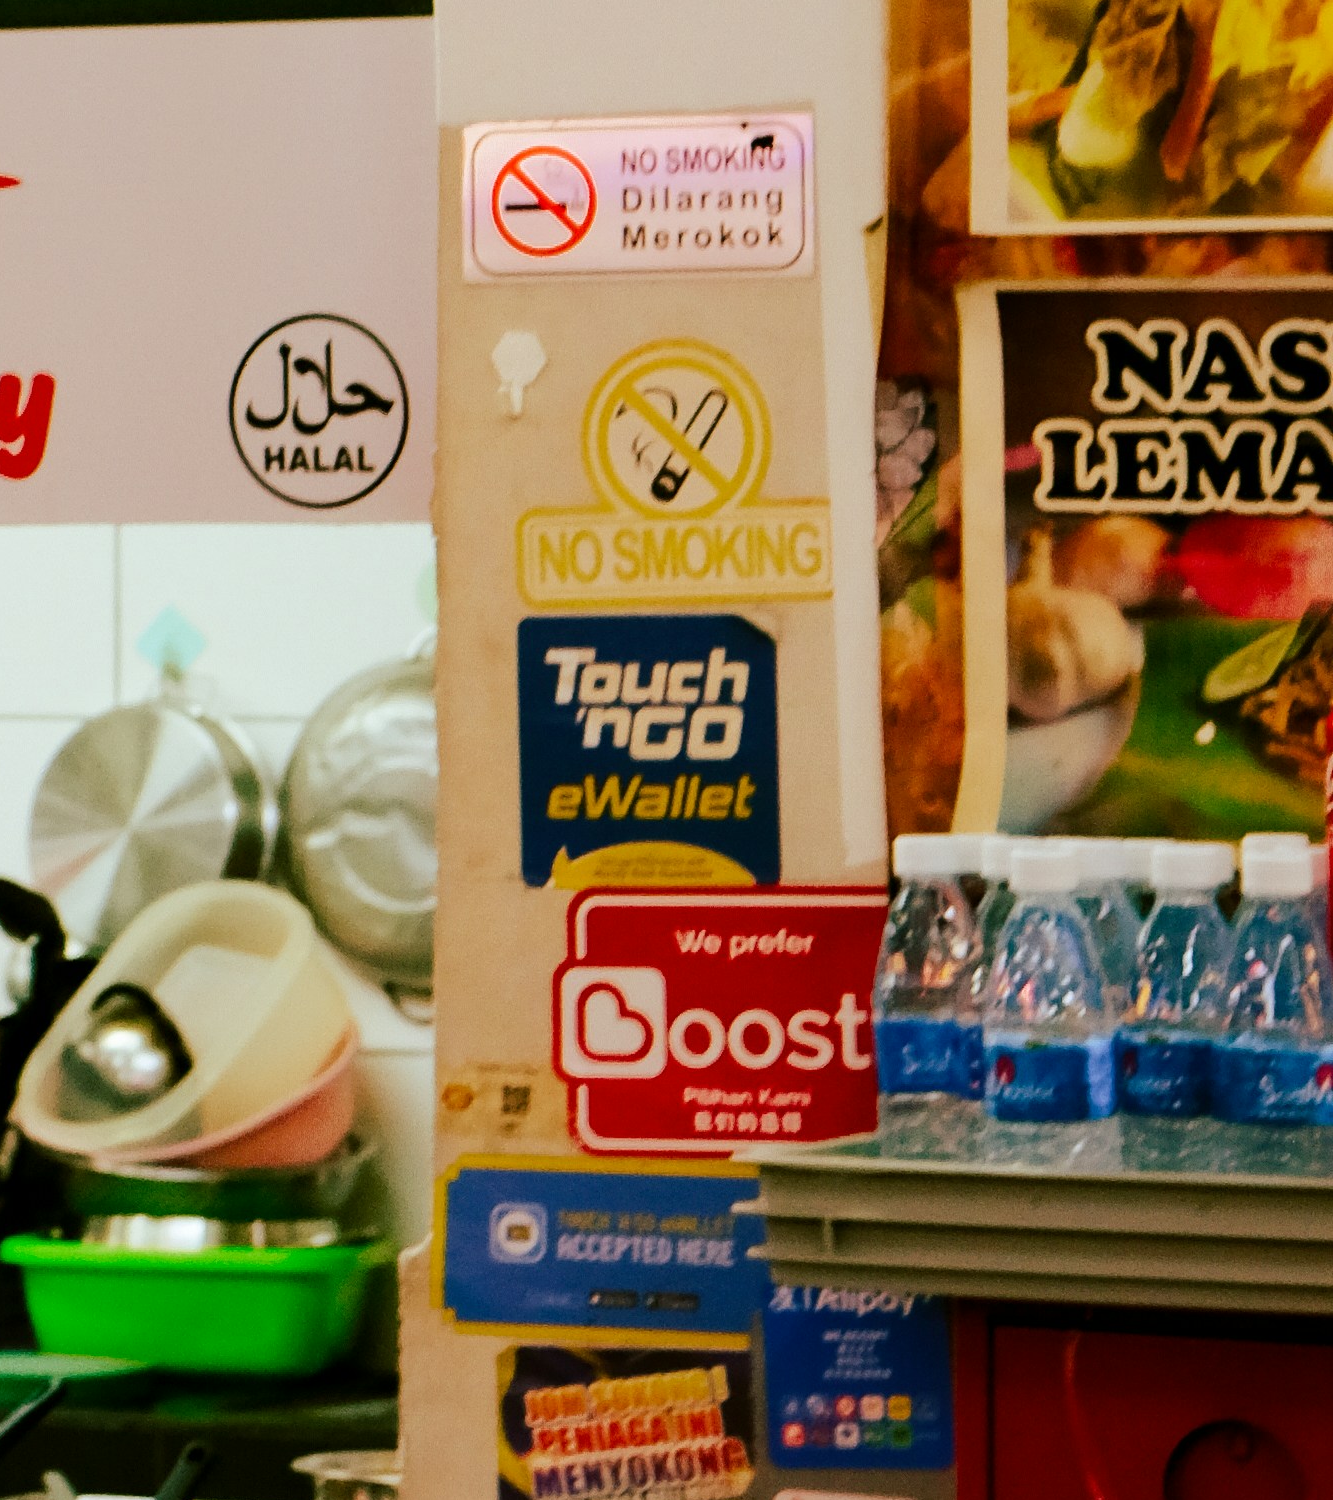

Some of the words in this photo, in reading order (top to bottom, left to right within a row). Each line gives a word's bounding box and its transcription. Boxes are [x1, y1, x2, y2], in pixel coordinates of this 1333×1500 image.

[621, 147, 658, 175] NO
[665, 145, 786, 174] SMOKING
[621, 184, 784, 216] Dilarang
[622, 221, 784, 250] Merokok
[245, 337, 394, 435] حلال
[264, 444, 375, 473] HALAL
[538, 527, 603, 584] NO
[613, 522, 823, 583] SMOKING
[543, 646, 751, 706] Touch
[545, 773, 757, 822] eWallet
[673, 928, 722, 955] We
[728, 927, 815, 959] prefer
[556, 1233, 674, 1265] ACCEPTED
